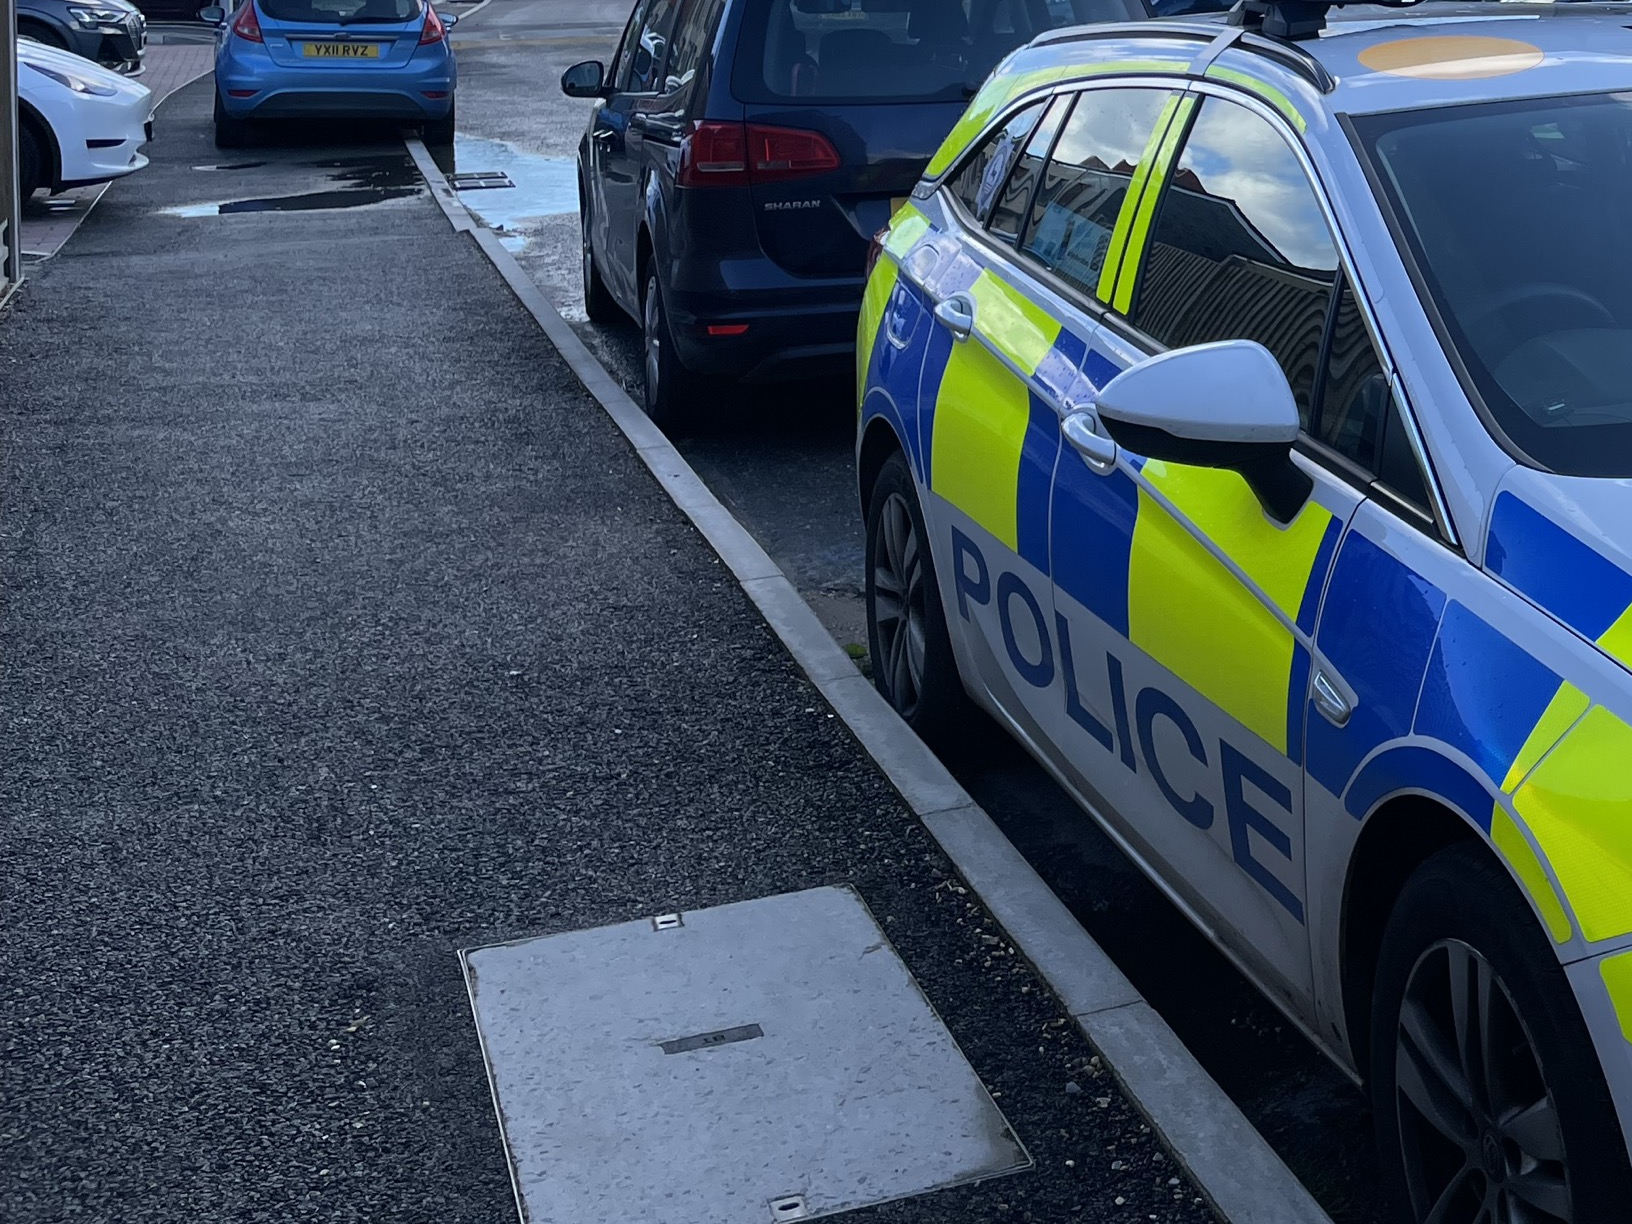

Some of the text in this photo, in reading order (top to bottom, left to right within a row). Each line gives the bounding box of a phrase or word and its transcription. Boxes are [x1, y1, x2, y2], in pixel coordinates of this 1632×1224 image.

[314, 44, 368, 56] YX11 RVZ
[764, 200, 821, 211] SHARAN
[951, 524, 1305, 926] POLICE
